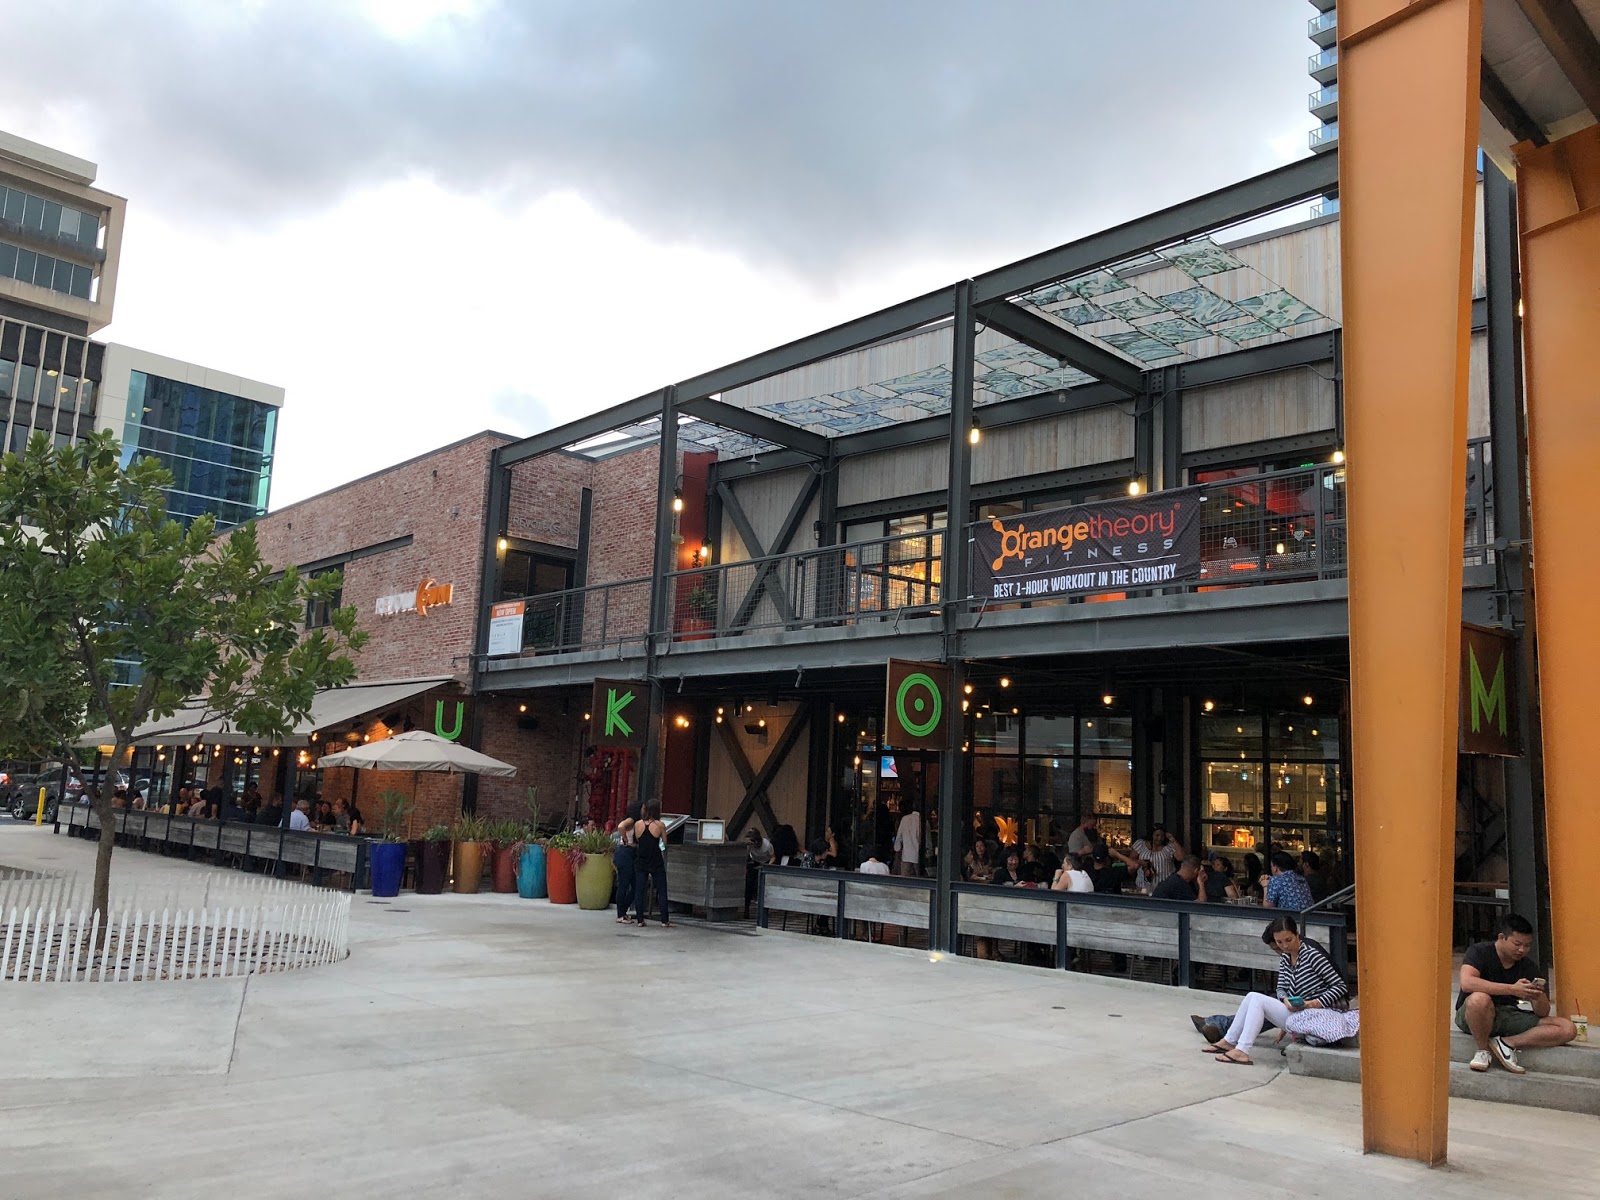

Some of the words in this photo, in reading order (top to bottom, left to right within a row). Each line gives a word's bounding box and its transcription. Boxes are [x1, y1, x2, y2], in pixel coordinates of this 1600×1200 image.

[1024, 538, 1174, 568] FITNESS
[993, 582, 1014, 598] BEST
[1015, 578, 1049, 595] 1-HOUR
[1050, 572, 1096, 592] WORKOUT
[1098, 571, 1110, 587] IN
[1112, 569, 1129, 586] THE
[1132, 563, 1177, 583] COUNTRY
[895, 672, 943, 737] O
[1468, 640, 1508, 737] M
[436, 700, 464, 740] U
[605, 688, 637, 737] K
